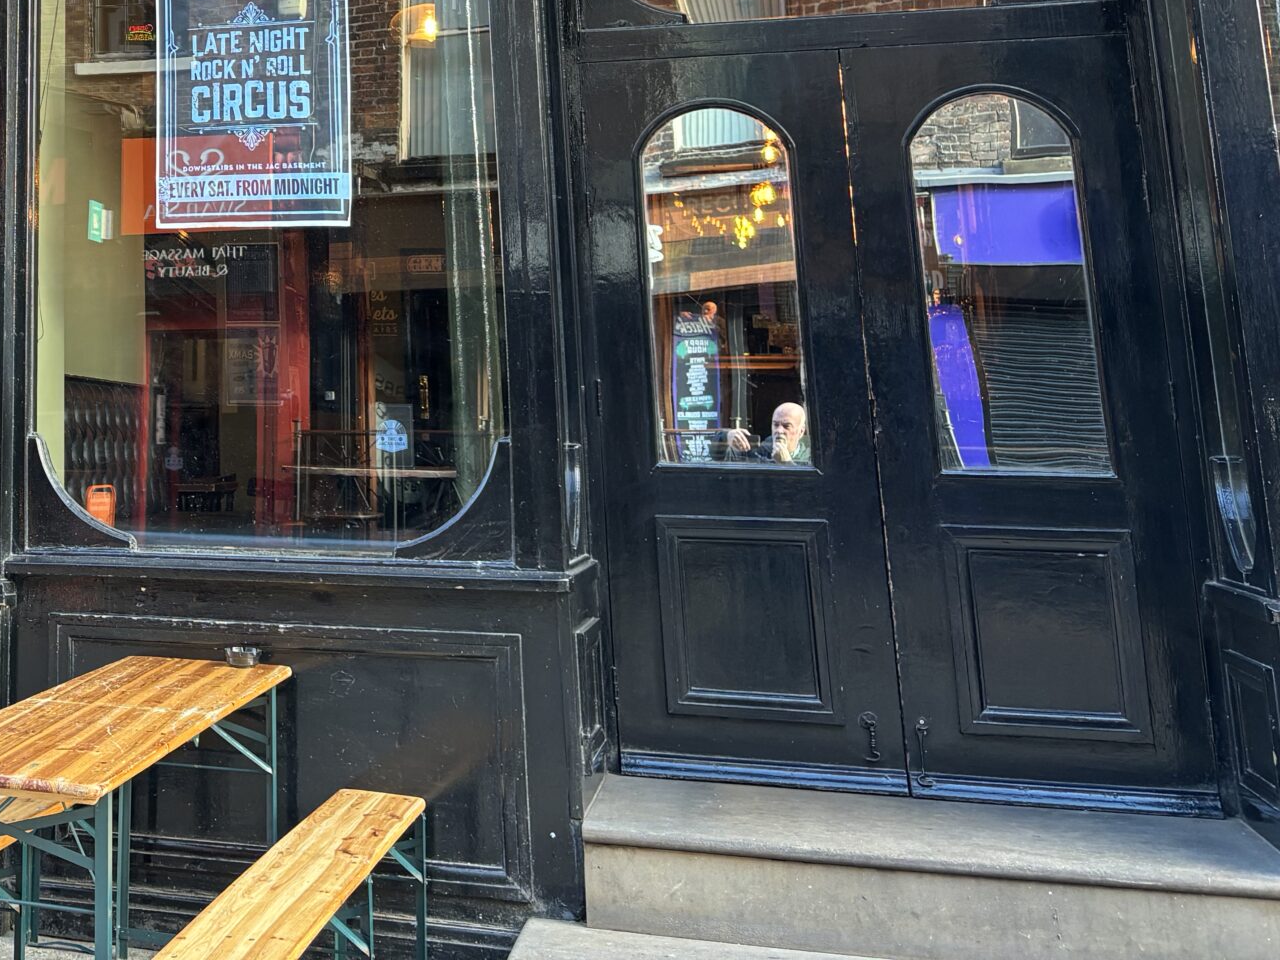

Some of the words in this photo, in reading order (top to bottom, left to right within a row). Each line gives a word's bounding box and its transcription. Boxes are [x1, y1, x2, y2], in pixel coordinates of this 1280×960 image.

[192, 30, 243, 57] LATE
[249, 27, 309, 53] NIGHT
[191, 58, 234, 81] ROCK
[266, 55, 311, 77] ROLL
[191, 80, 311, 123] CIRCUS
[182, 164, 234, 173] DOWNSTAIRS
[245, 163, 263, 171] THE
[265, 162, 280, 170] JAC
[282, 161, 326, 170] BASEMENT
[170, 180, 206, 199] EVERY
[208, 180, 234, 198] SAT.
[236, 179, 271, 197] FROM
[274, 177, 339, 196] MIDNIGHT
